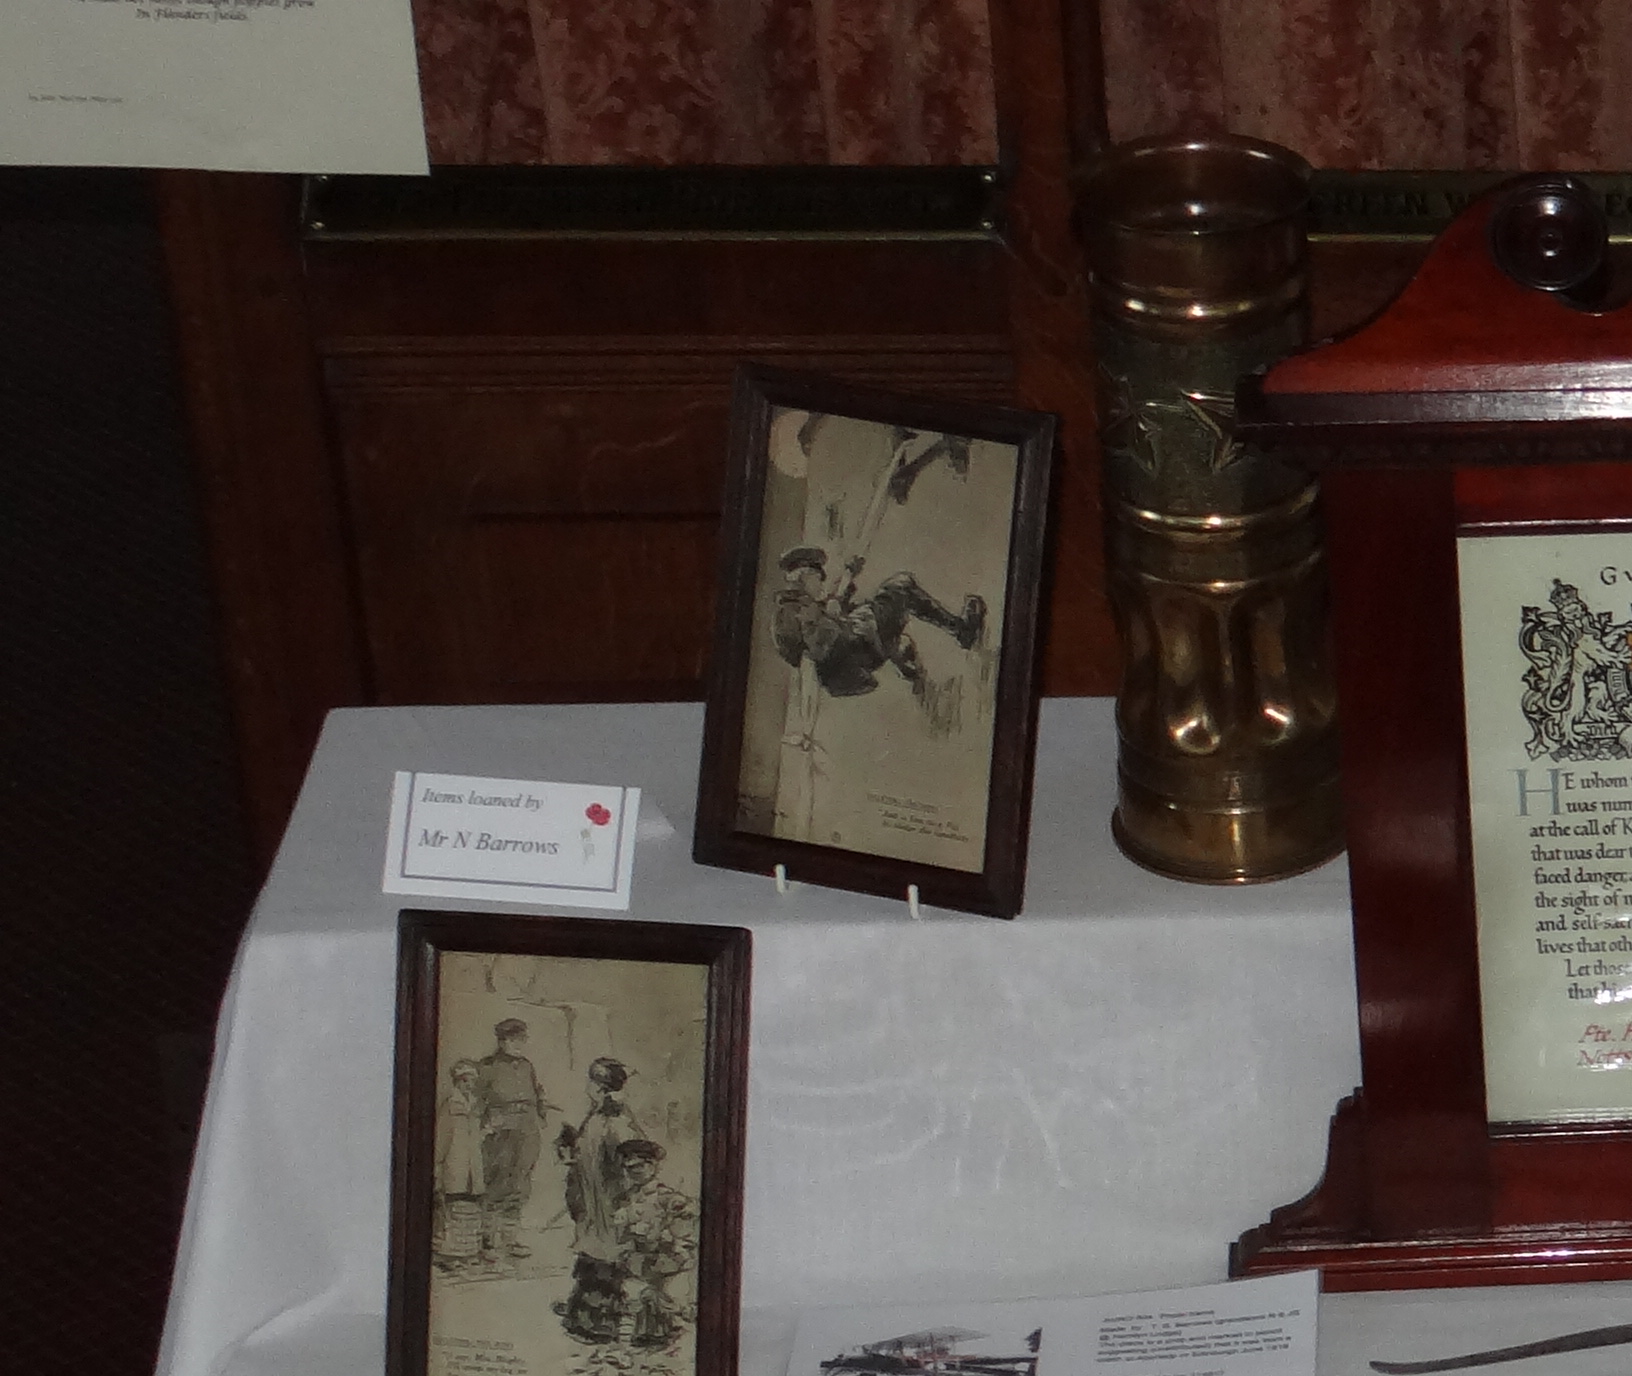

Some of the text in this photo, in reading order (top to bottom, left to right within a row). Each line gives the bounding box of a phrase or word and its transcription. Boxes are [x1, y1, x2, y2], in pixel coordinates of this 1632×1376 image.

[1581, 771, 1628, 789] whom
[422, 787, 545, 812] Items loaned by
[1573, 819, 1599, 836] call
[1602, 817, 1620, 836] of
[418, 828, 561, 855] Mr N Barrows
[1535, 891, 1558, 909] the
[1560, 890, 1599, 915] sight
[1603, 889, 1621, 907] of
[1536, 938, 1574, 955] lives
[1577, 936, 1606, 953] that
